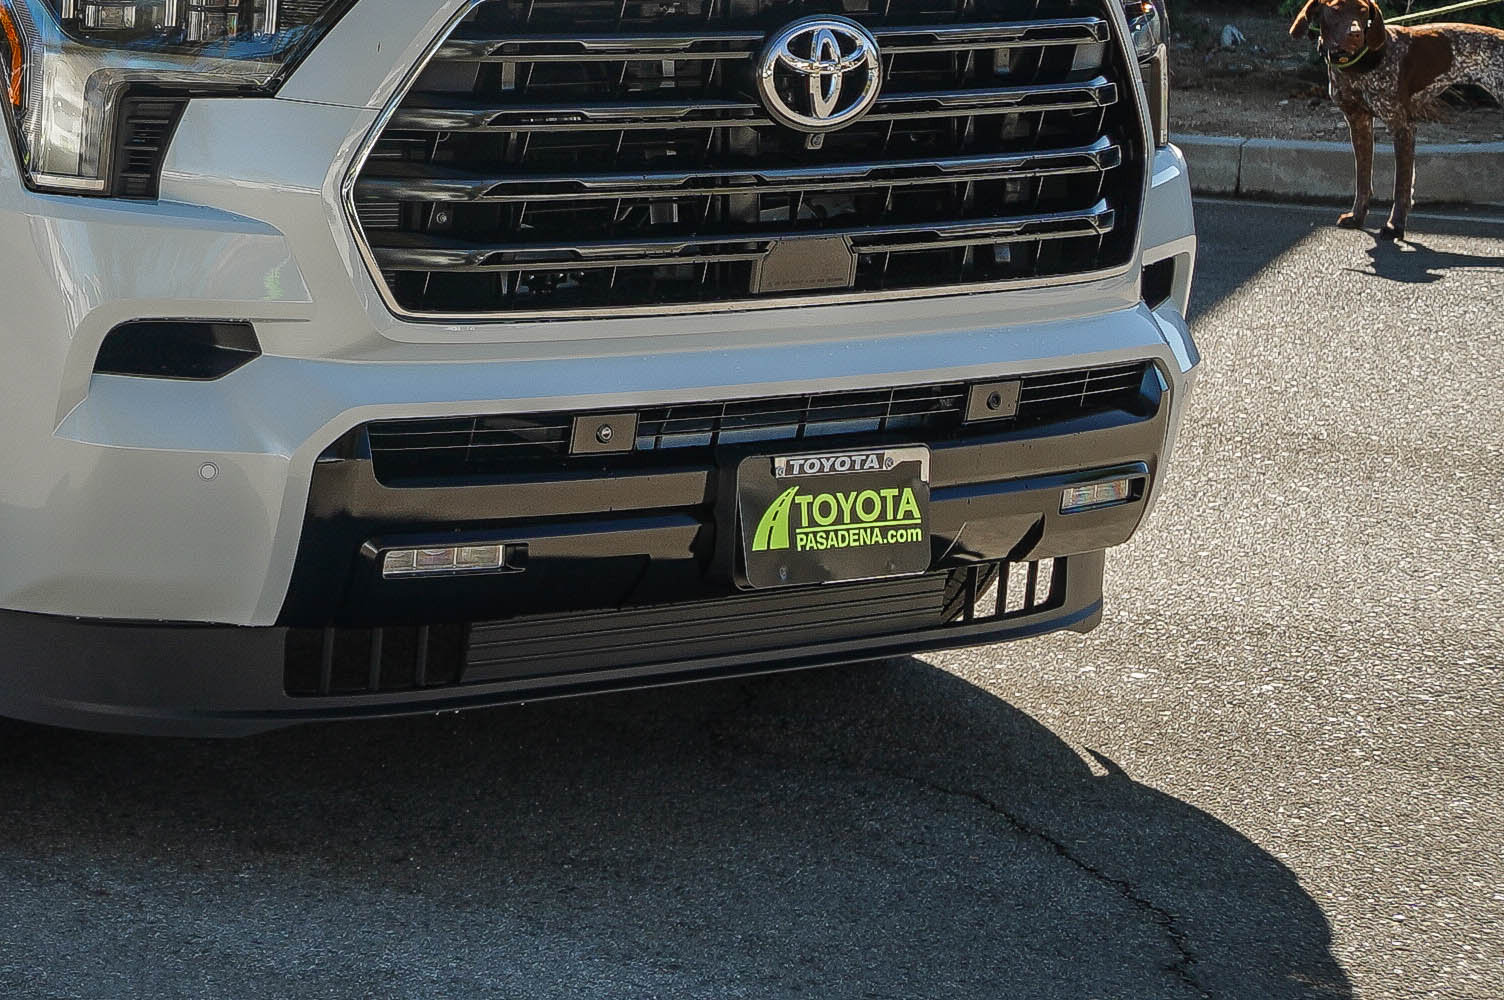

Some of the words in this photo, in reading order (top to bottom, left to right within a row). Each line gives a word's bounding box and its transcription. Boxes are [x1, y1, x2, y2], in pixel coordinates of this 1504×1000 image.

[790, 454, 879, 475] TOYOTA
[795, 487, 921, 527] TOYOTA
[796, 527, 922, 551] PASADENA.com
